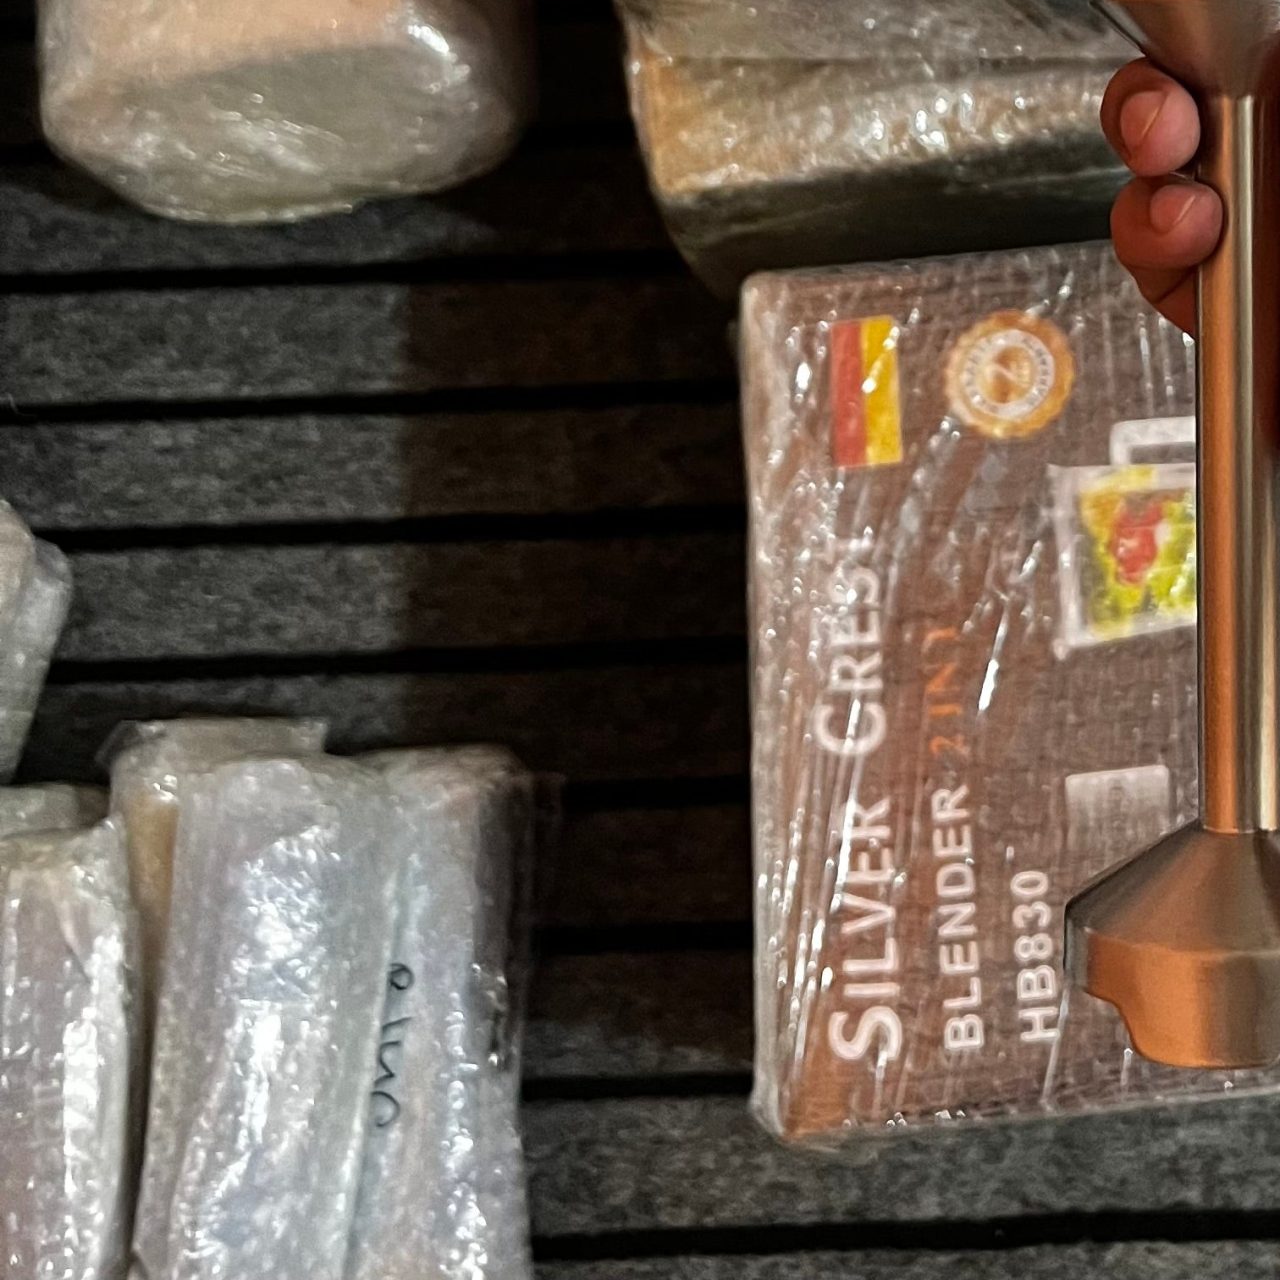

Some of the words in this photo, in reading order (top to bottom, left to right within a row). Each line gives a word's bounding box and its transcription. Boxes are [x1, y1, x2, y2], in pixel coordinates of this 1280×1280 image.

[813, 533, 887, 755] CREST
[828, 796, 903, 1061] SILVER
[931, 784, 985, 1051] BLENDER
[1010, 869, 1060, 1042] HB830
